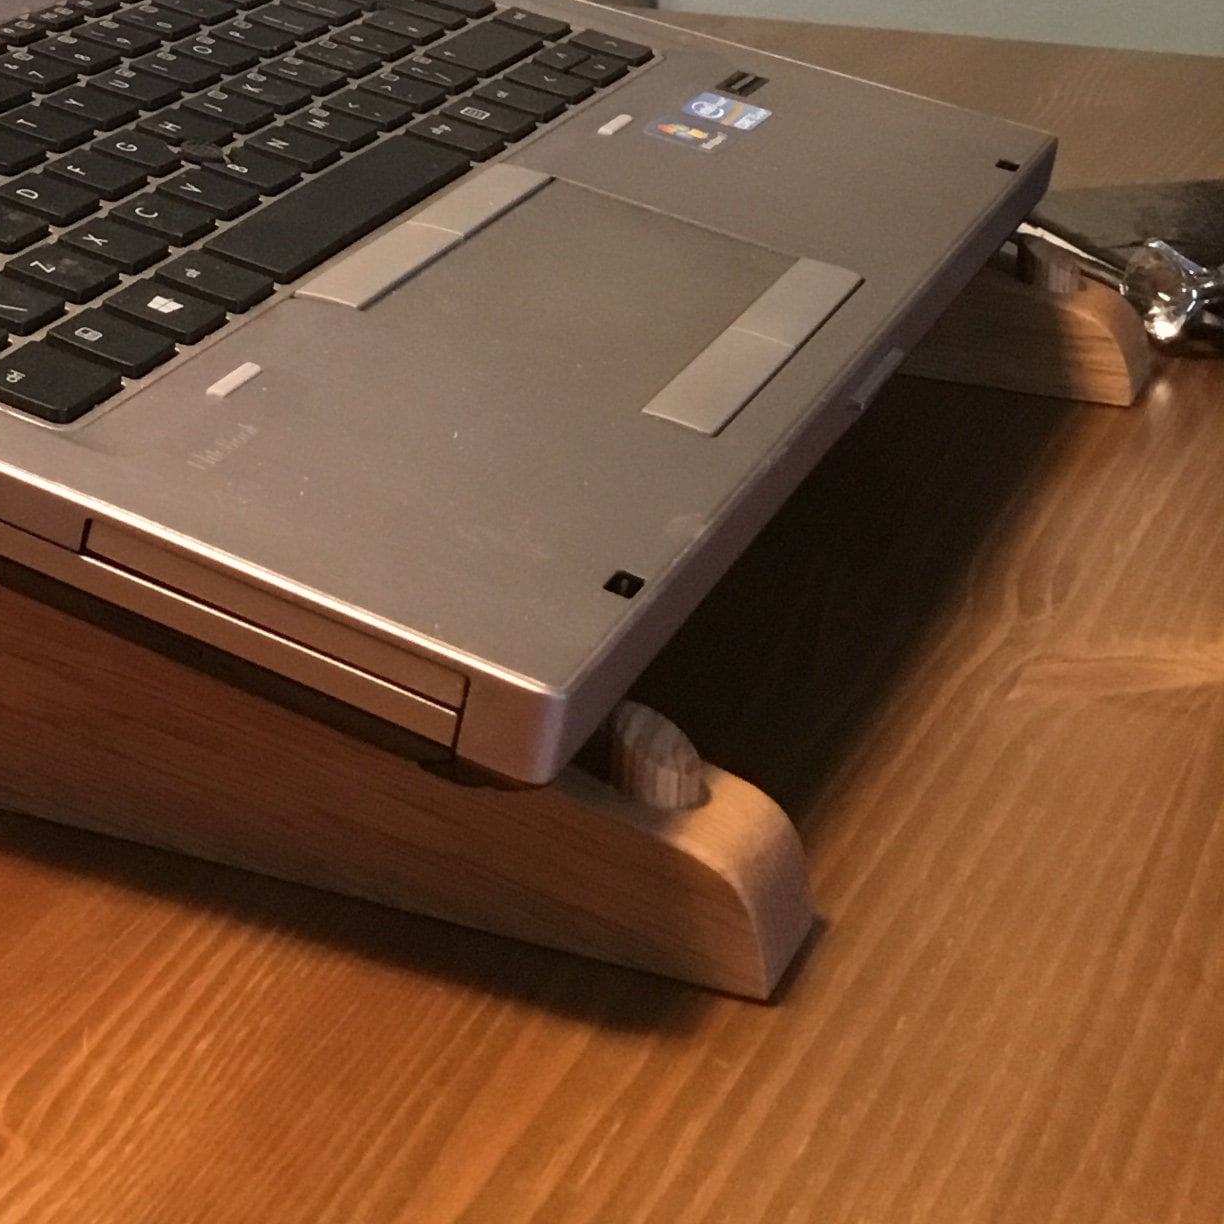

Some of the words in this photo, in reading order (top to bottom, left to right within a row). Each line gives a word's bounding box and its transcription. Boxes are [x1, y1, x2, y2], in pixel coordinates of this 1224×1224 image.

[241, 83, 264, 94] K
[64, 97, 85, 108] Y
[158, 120, 182, 132] H
[307, 118, 330, 129] M
[115, 141, 138, 152] G
[266, 137, 289, 150] N
[66, 164, 86, 176] F
[227, 163, 249, 174] B
[179, 182, 202, 193] V
[15, 188, 39, 200] D
[134, 206, 159, 218] C
[82, 233, 109, 246] X
[29, 260, 56, 273] Z
